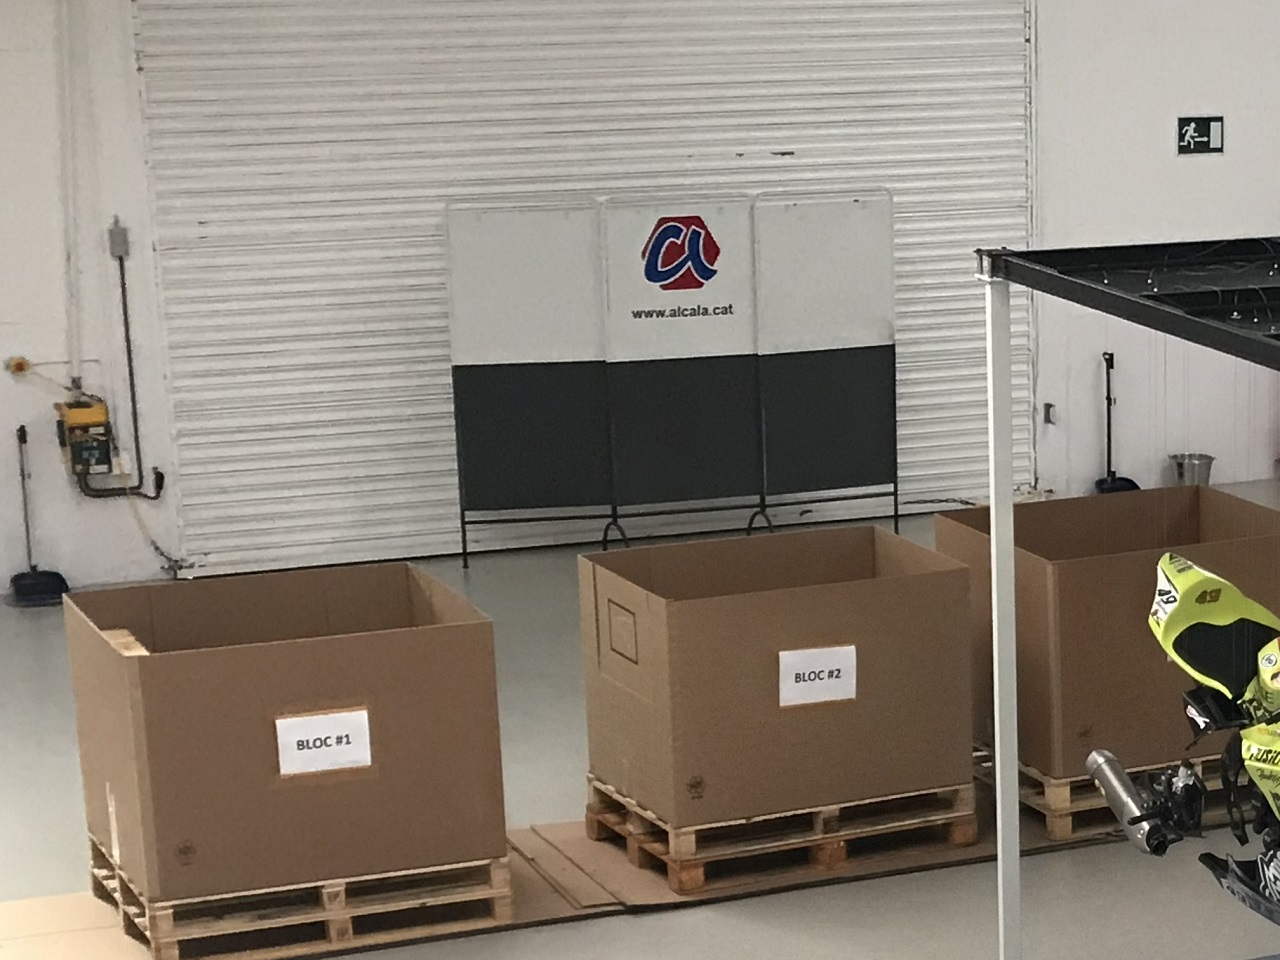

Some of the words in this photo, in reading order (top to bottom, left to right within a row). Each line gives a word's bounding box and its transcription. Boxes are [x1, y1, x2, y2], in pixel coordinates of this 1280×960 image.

[631, 303, 734, 319] www.alcala.cat
[1157, 588, 1177, 605] 49
[794, 669, 825, 684] BLOC
[827, 668, 841, 680] #2
[296, 736, 332, 751] BLOC
[335, 733, 352, 746] #1
